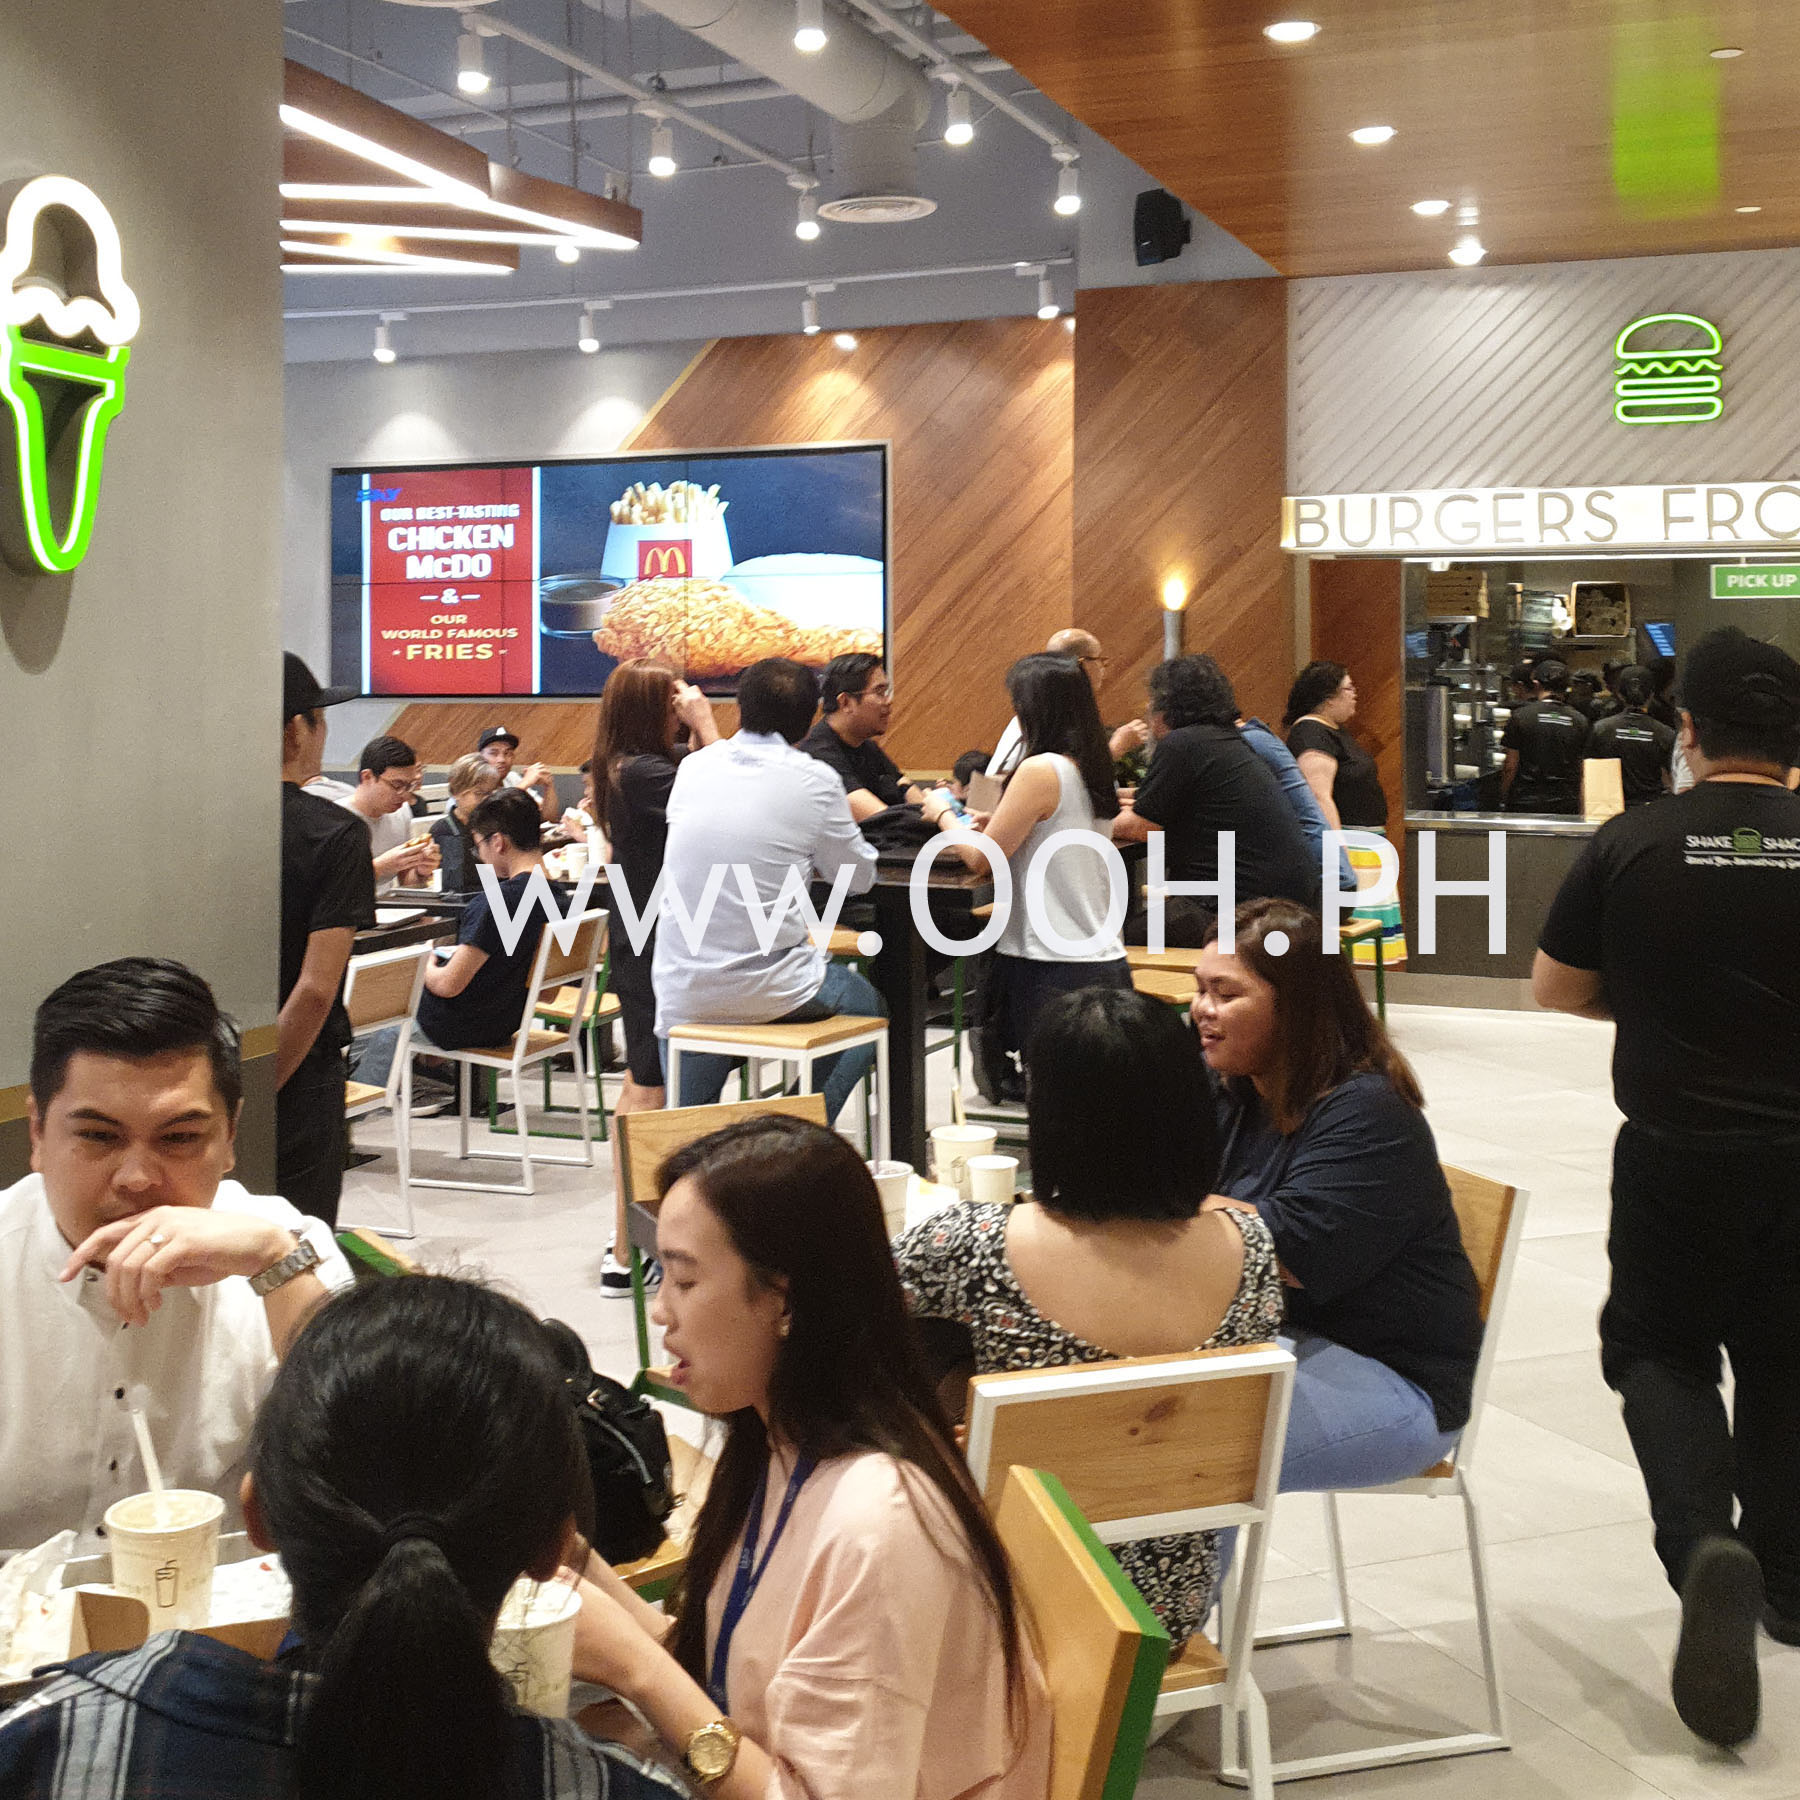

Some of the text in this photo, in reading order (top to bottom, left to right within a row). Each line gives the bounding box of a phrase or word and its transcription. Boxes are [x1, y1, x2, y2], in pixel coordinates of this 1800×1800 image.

[1295, 485, 1800, 548] BURGERS FRO
[387, 523, 515, 551] CHICKEN
[1727, 573, 1798, 588] PICK UP
[440, 588, 460, 604] &
[430, 614, 469, 625] OUR
[381, 628, 518, 640] WORLD FAMOUS
[406, 643, 494, 660] FRIES
